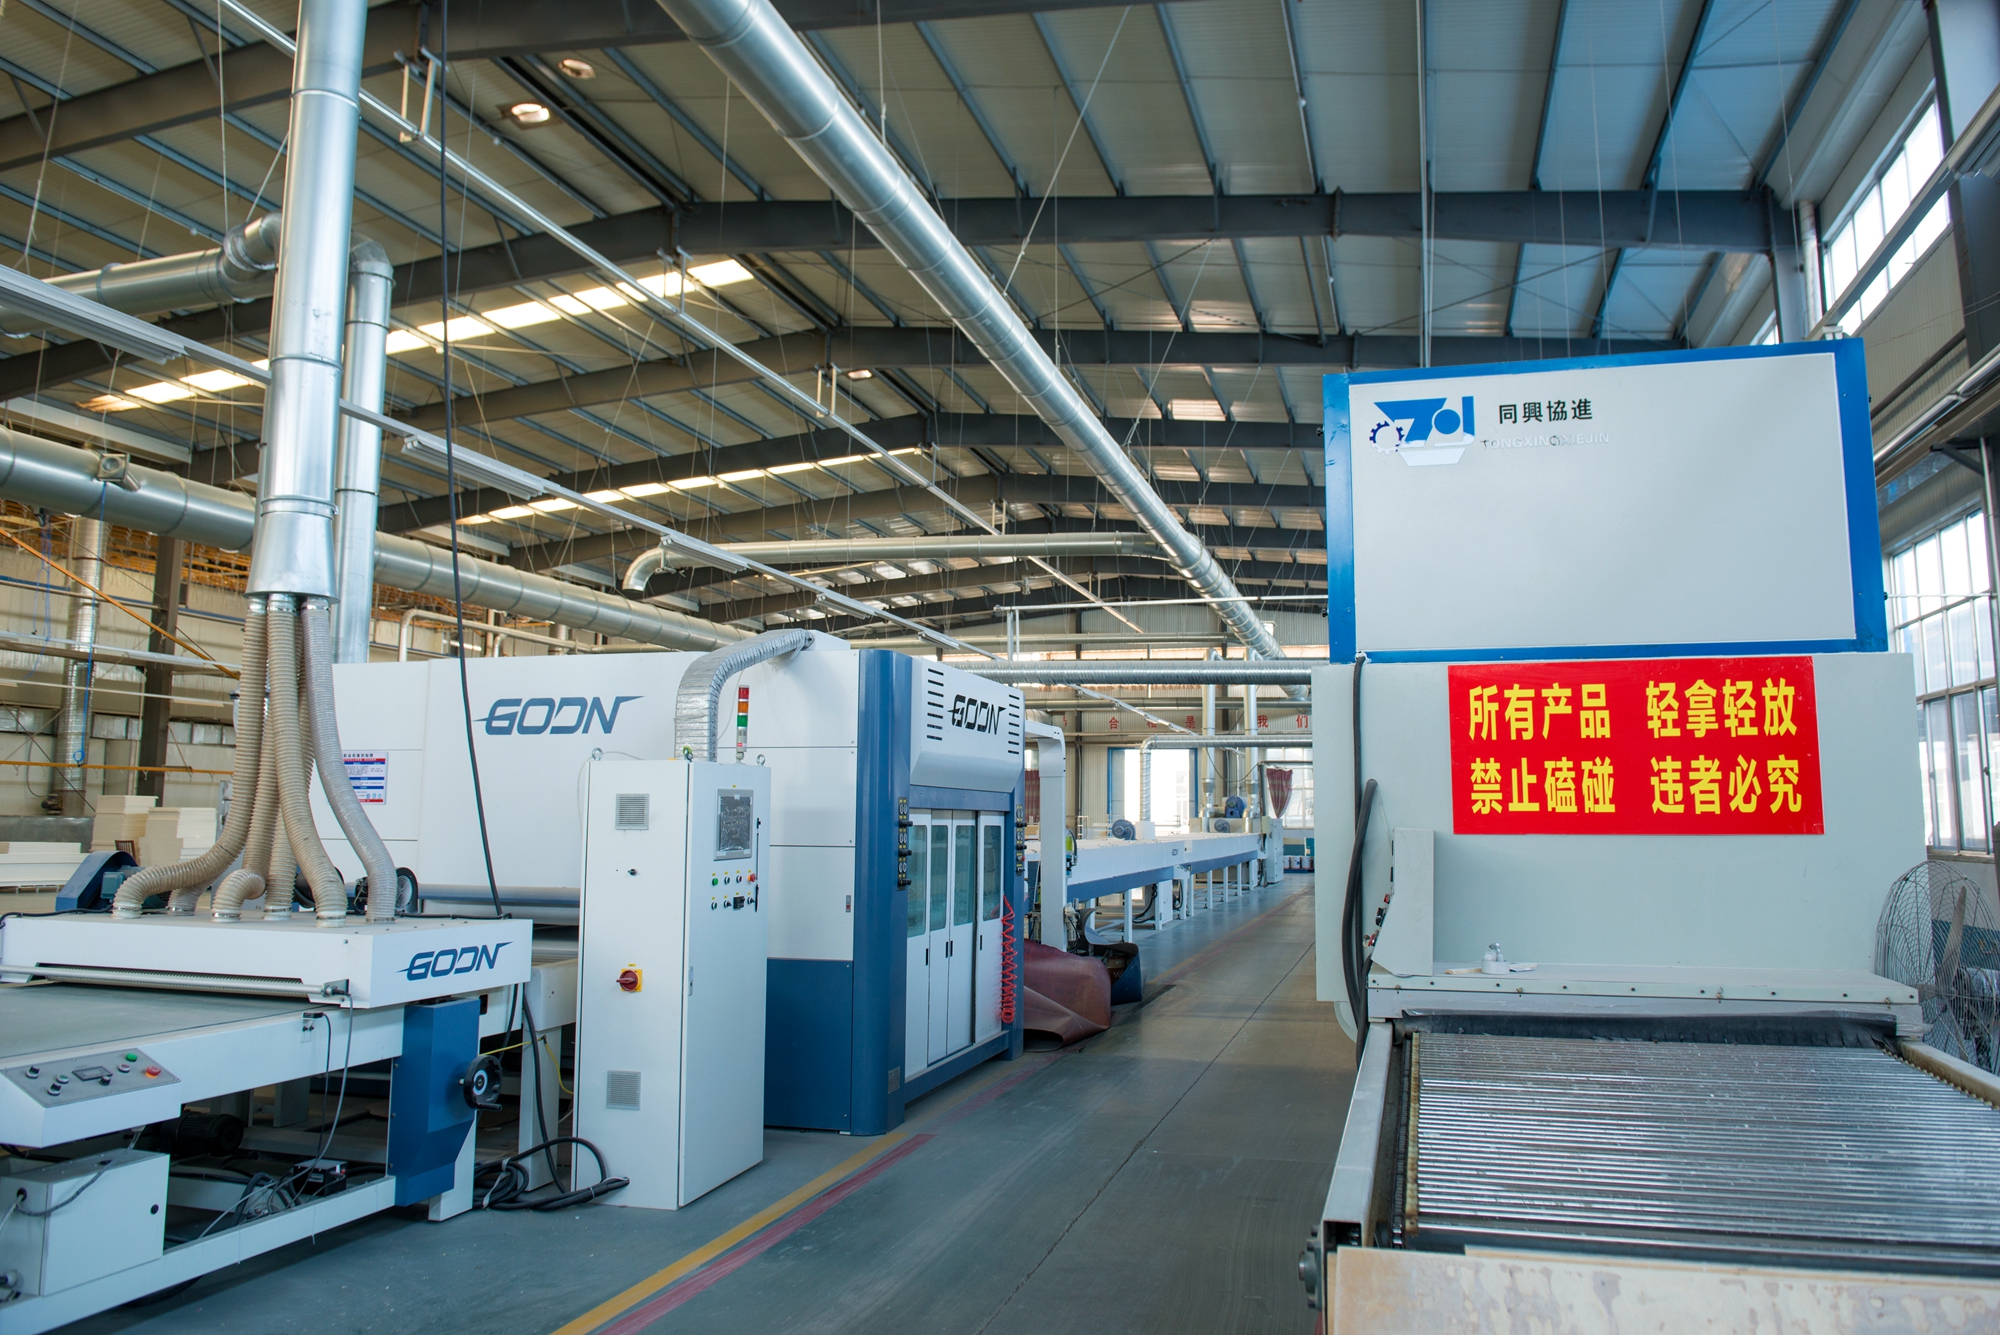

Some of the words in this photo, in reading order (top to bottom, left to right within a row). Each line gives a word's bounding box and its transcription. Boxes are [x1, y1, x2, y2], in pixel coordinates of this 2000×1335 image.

[1499, 398, 1593, 424] 同興協進
[1469, 683, 1611, 740] 所有产品
[1646, 678, 1797, 738] 轻拿轻放
[1471, 757, 1616, 814] 禁止磕碰
[1651, 754, 1802, 814] 违者必究
